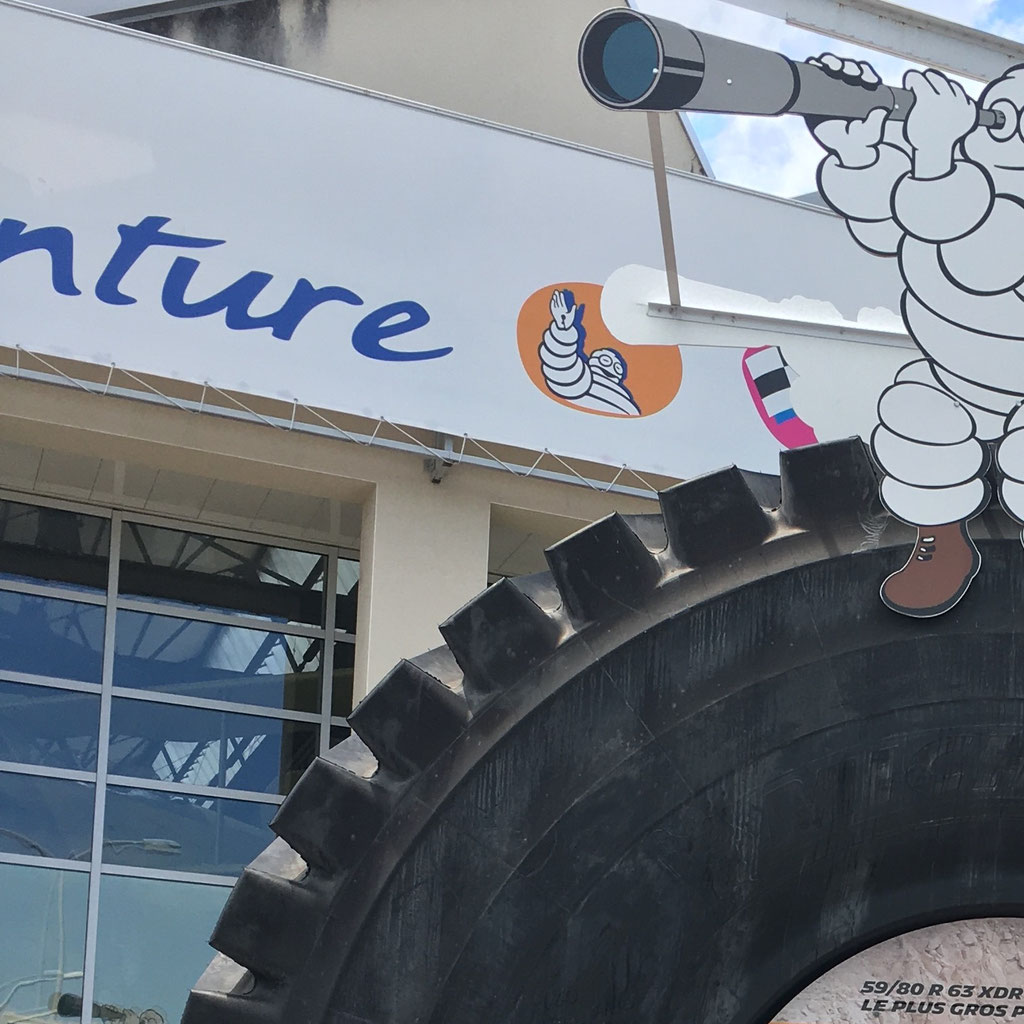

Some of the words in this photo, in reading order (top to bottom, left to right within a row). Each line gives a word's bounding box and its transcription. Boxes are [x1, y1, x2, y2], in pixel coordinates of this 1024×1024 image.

[861, 980, 924, 996] 59/80
[928, 984, 944, 997] R
[948, 985, 975, 998] 63
[977, 986, 1024, 1000] XDR
[861, 999, 888, 1012] LE
[891, 1000, 946, 1014] PLUS
[950, 1003, 1009, 1017] GROS
